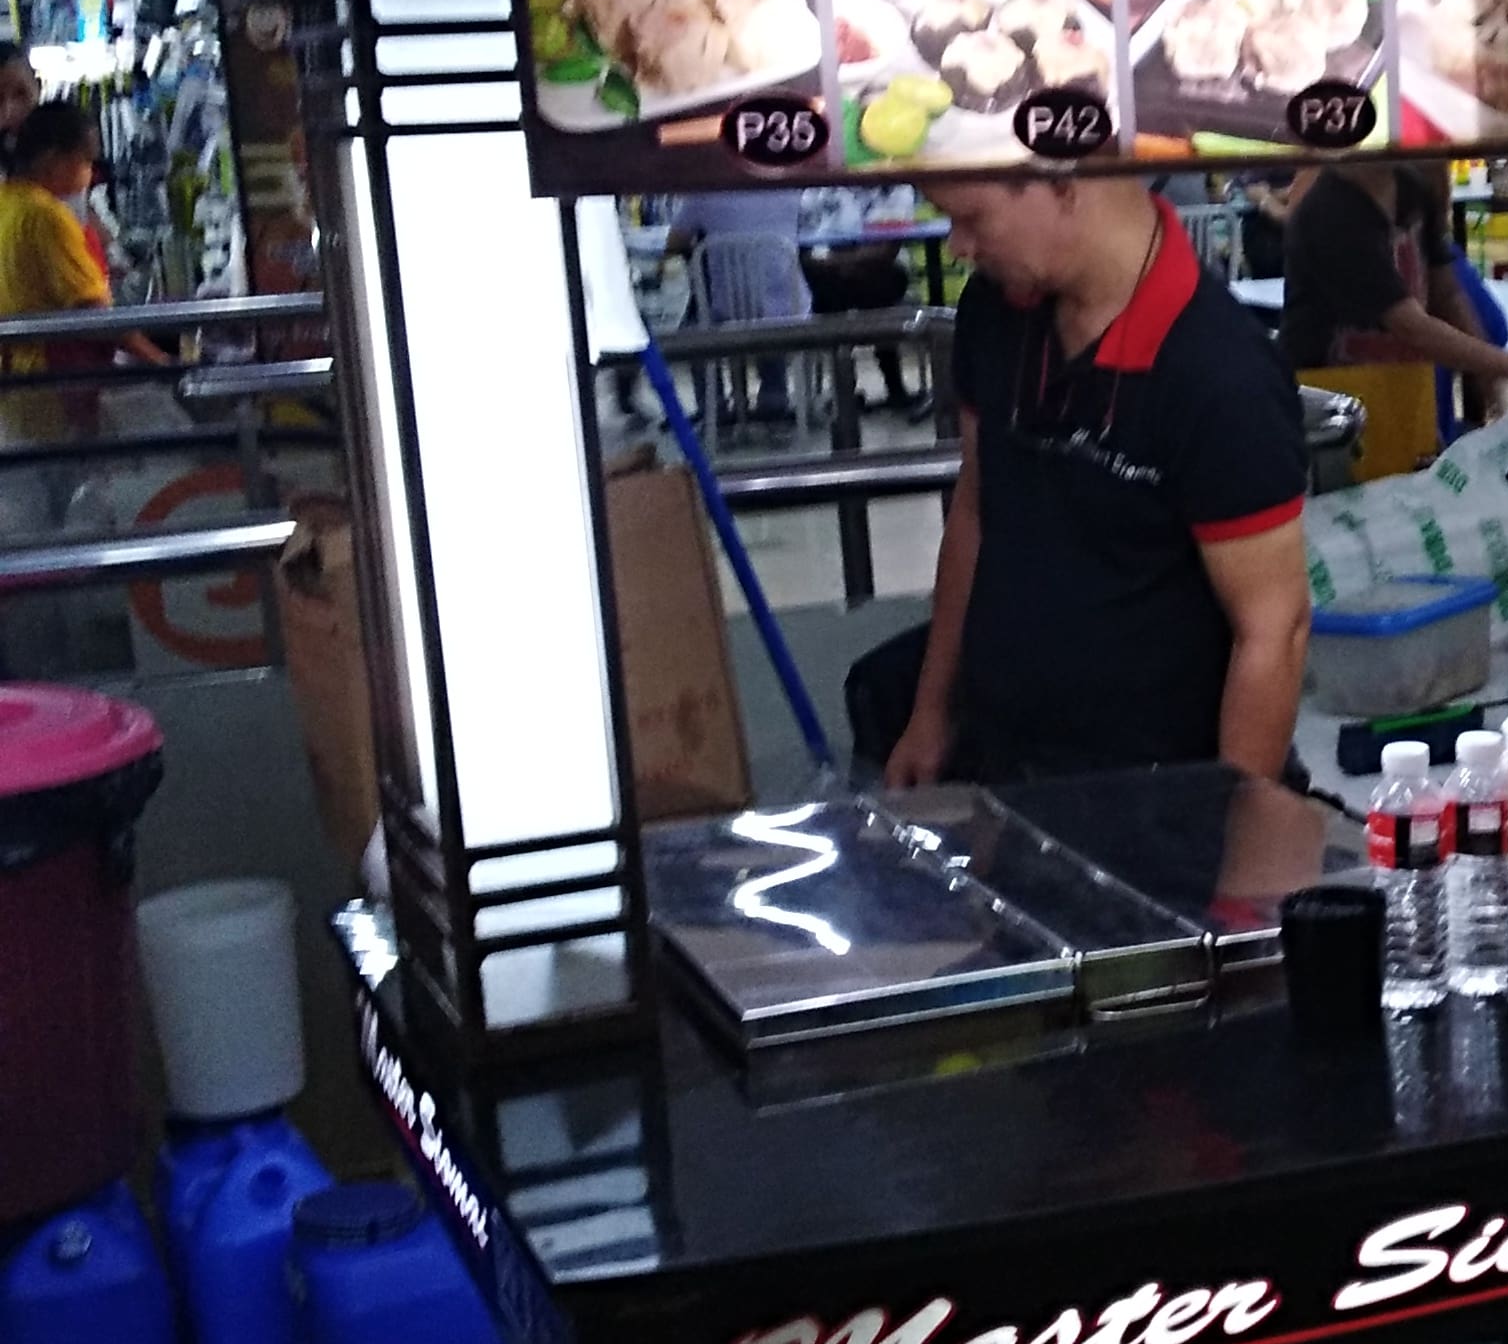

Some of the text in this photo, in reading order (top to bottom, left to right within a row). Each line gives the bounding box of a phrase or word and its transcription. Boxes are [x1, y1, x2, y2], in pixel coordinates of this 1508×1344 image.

[736, 109, 815, 154] P35
[1028, 105, 1100, 144] P42
[1300, 98, 1365, 134] P37
